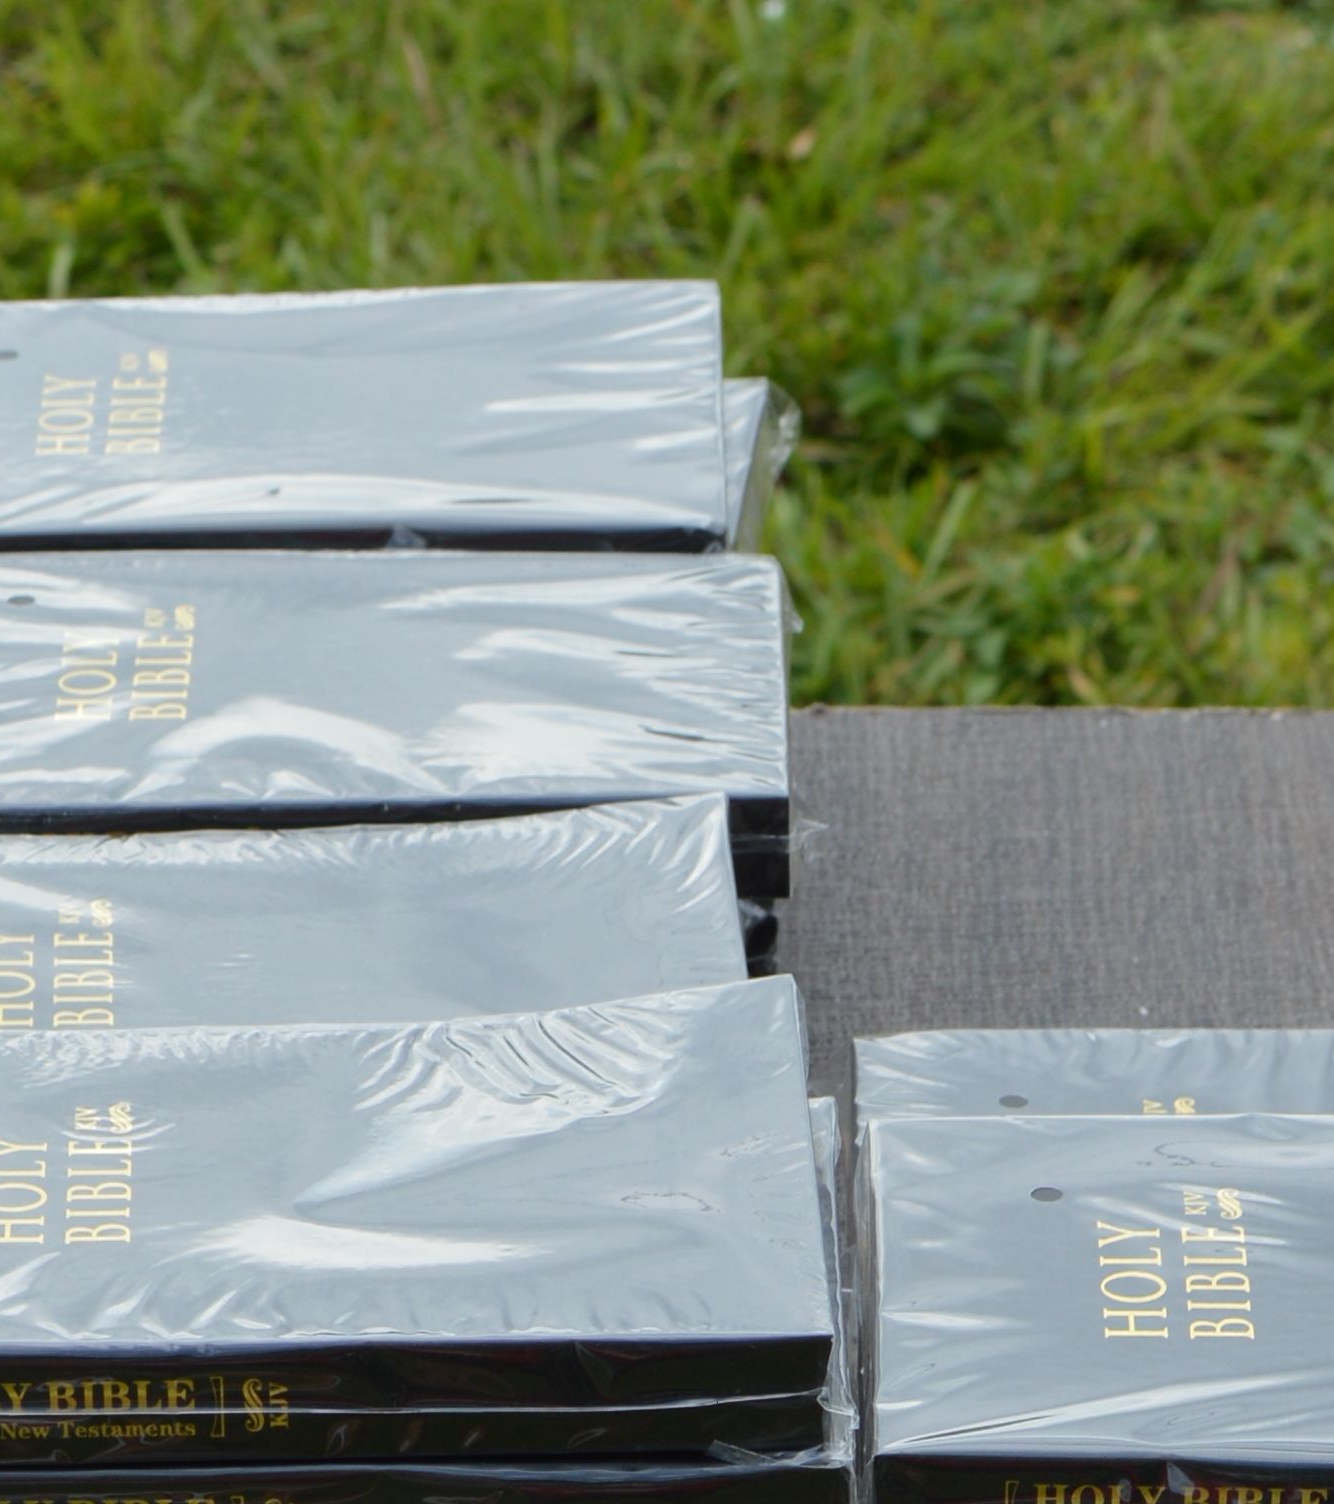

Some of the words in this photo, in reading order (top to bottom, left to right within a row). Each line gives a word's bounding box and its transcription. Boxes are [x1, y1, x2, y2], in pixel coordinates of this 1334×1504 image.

[35, 374, 97, 456] HOLY
[105, 376, 168, 454] BIBLE
[55, 632, 121, 722] HOLY
[129, 631, 195, 721] BIBLE
[53, 931, 114, 1027] BIBLE
[65, 1139, 133, 1244] BIBLE
[1096, 1220, 1169, 1339] HOLY
[1181, 1225, 1255, 1340] BIBLE
[0, 1419, 51, 1441] New
[60, 1419, 197, 1441] Testaments
[49, 1379, 195, 1411] BIBLE
